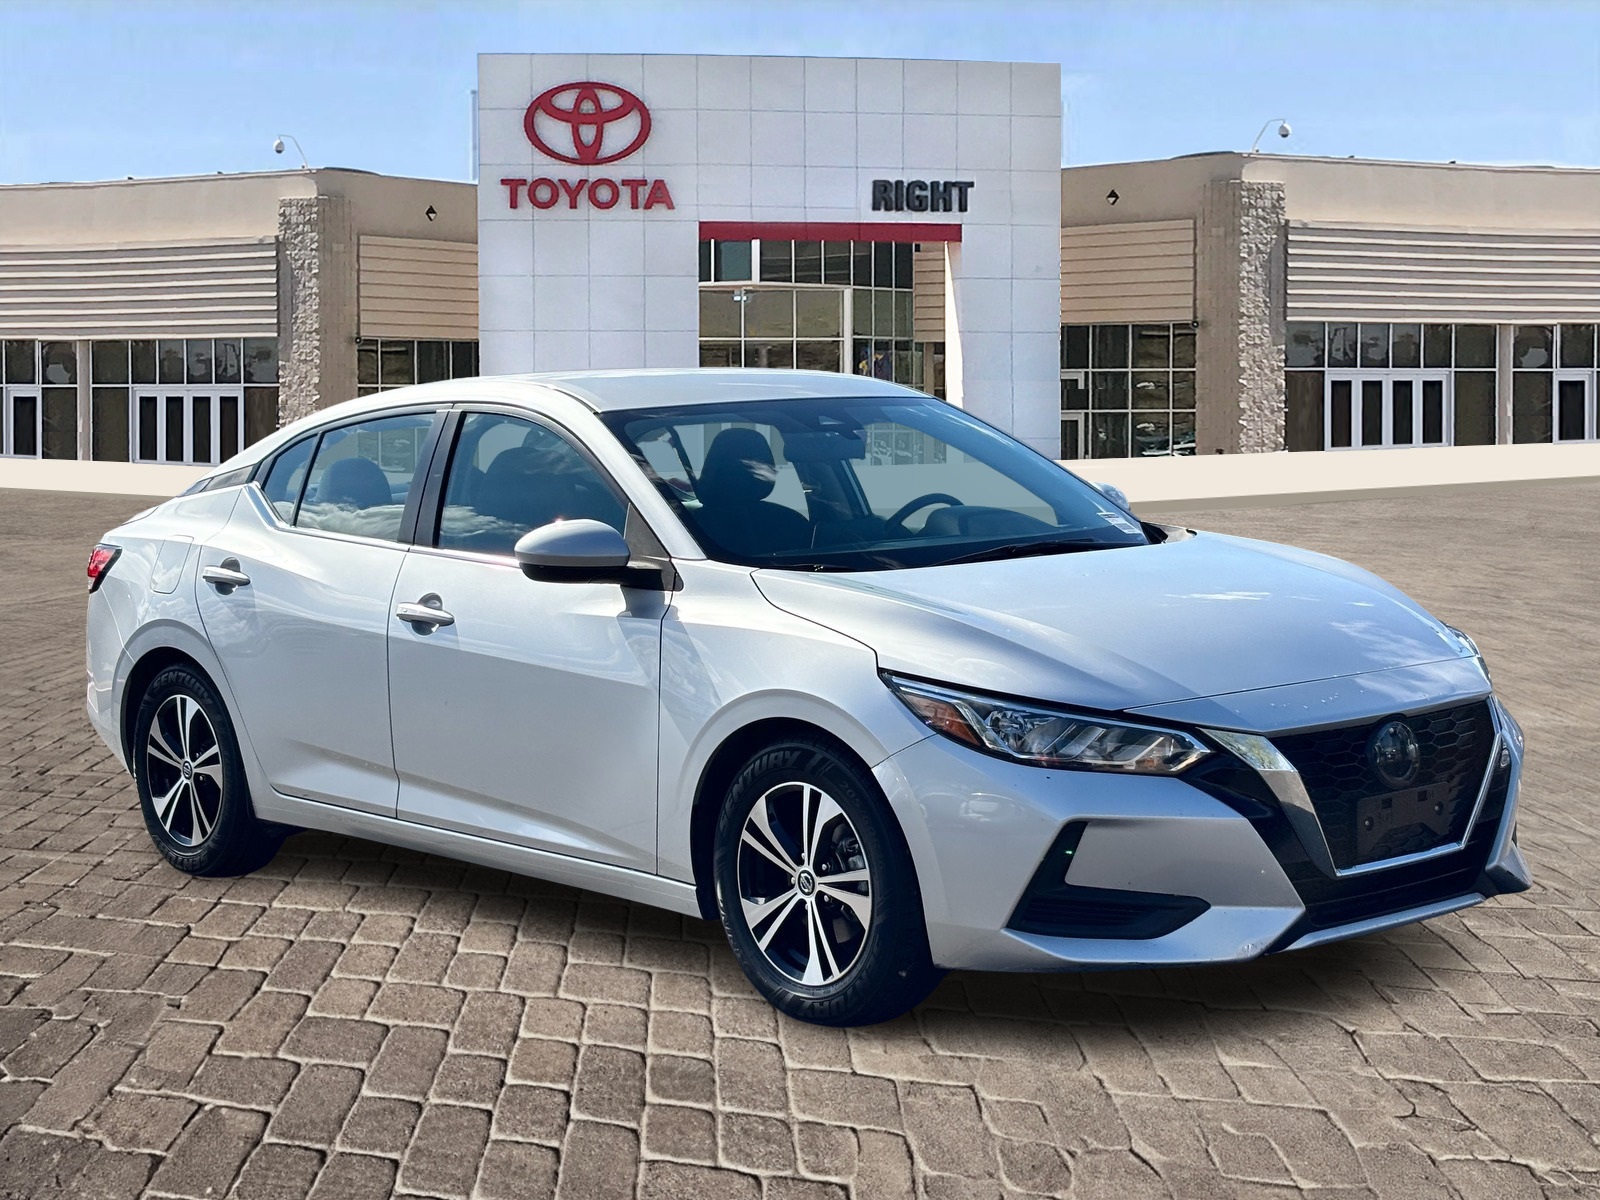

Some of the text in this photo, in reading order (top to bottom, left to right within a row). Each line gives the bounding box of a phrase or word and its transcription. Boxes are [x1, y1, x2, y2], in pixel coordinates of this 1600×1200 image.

[500, 178, 675, 210] TOYOTA
[871, 179, 975, 212] RIGHT
[153, 671, 213, 706] SENTURY
[719, 750, 803, 832] SENTURY
